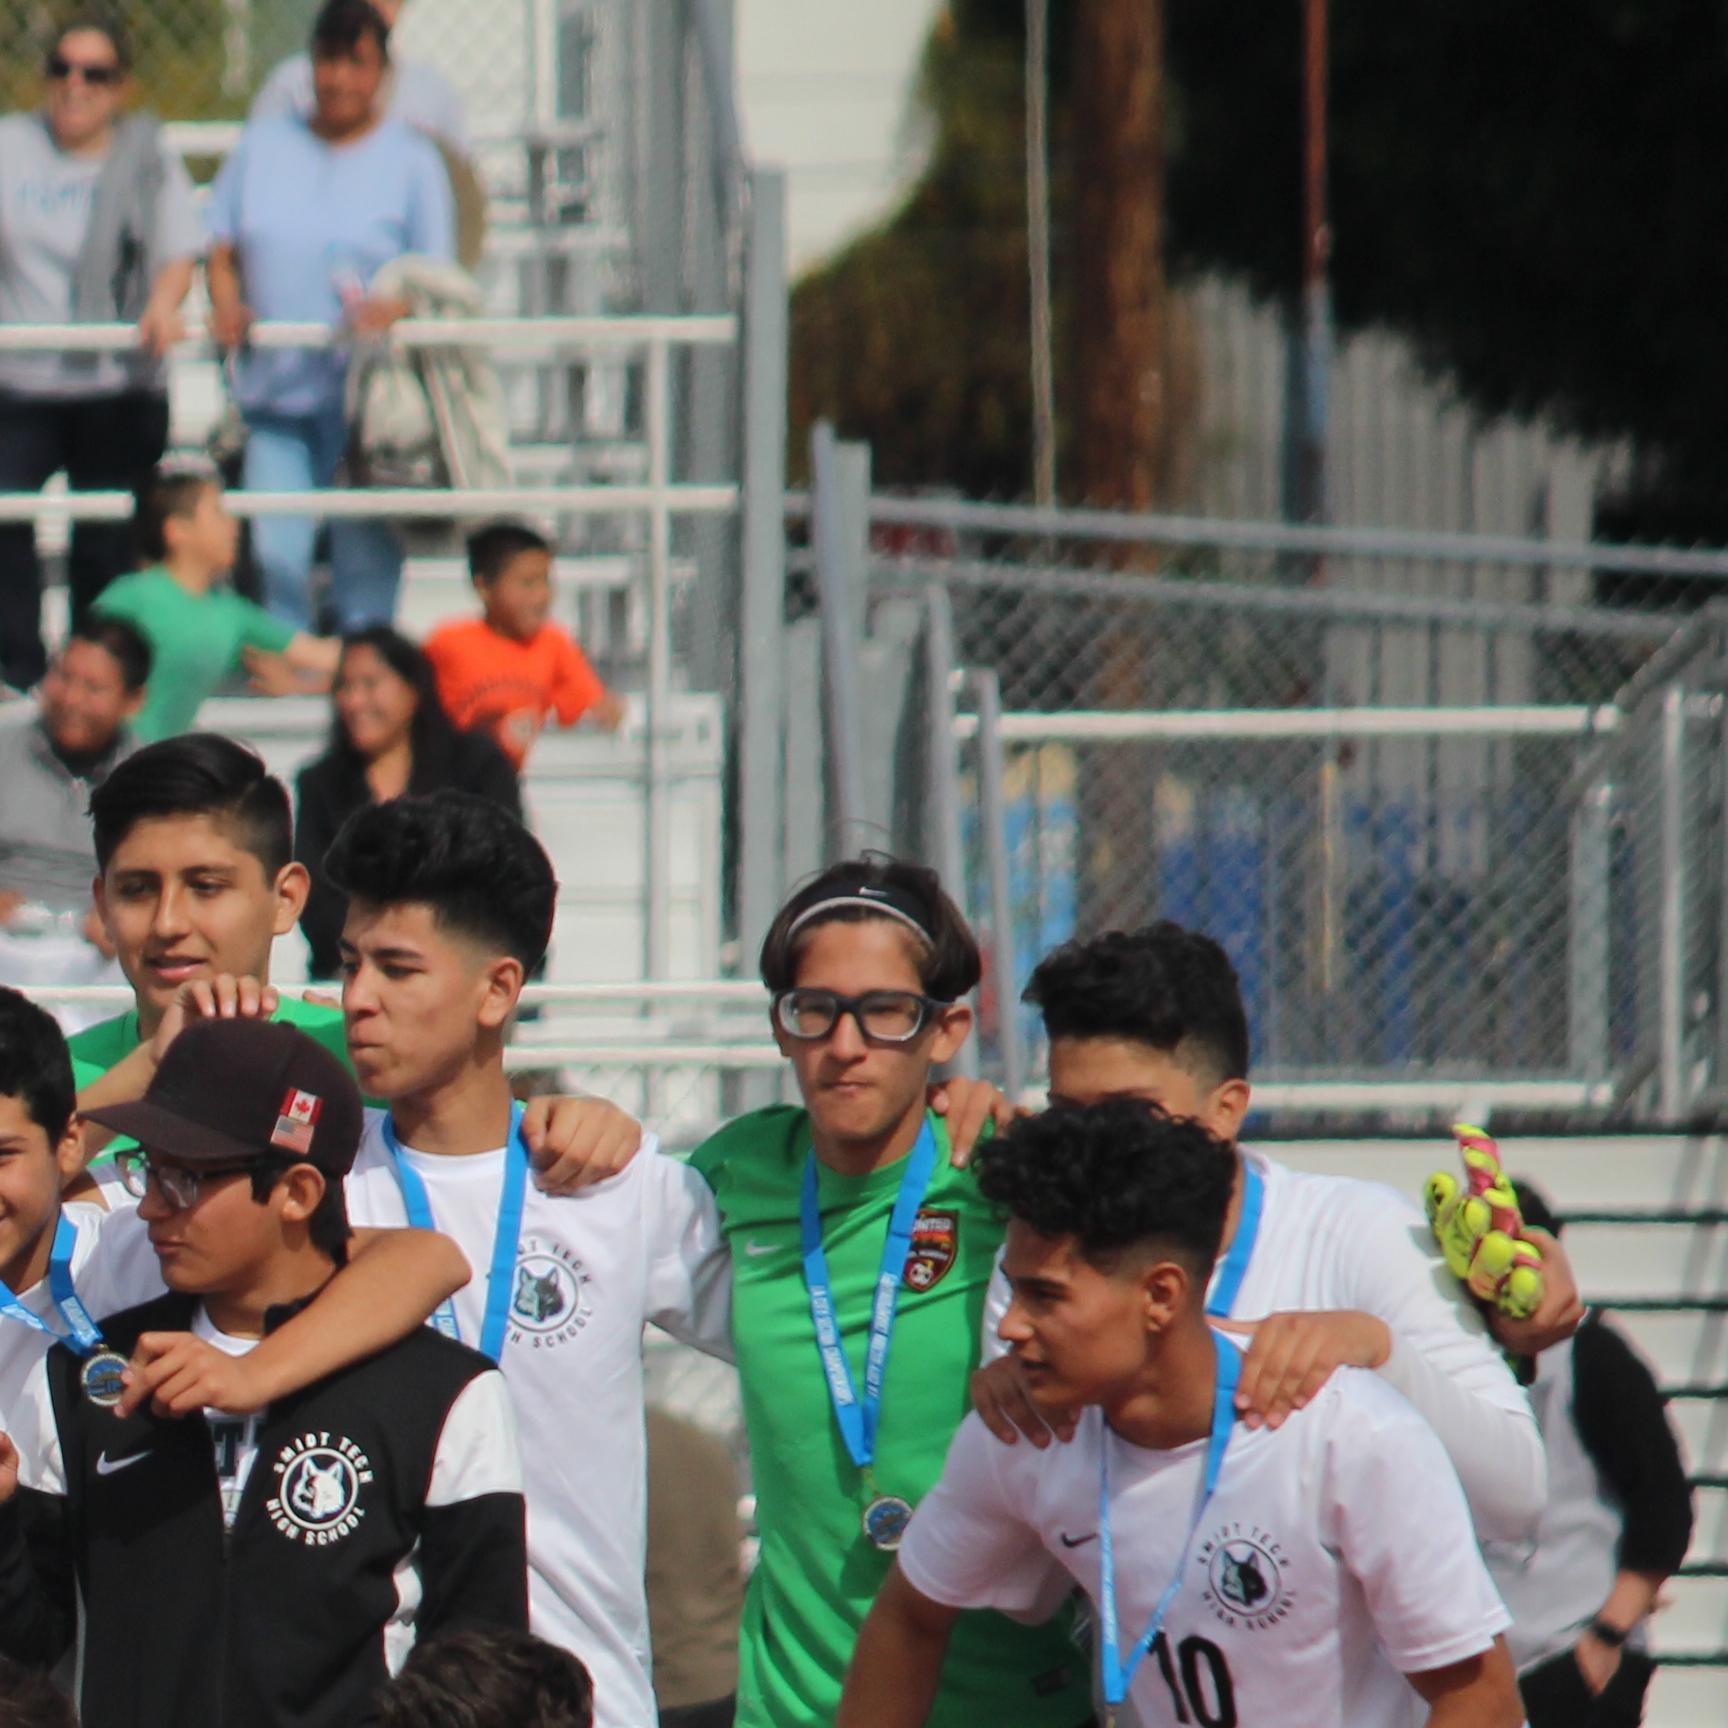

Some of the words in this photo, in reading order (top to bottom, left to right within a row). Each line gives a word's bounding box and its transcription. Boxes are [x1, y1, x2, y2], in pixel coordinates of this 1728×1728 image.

[273, 1431, 330, 1473] SMIDT
[339, 1436, 374, 1483] TECH
[266, 1498, 301, 1539] HIGH
[305, 1506, 365, 1545] SCHOOL
